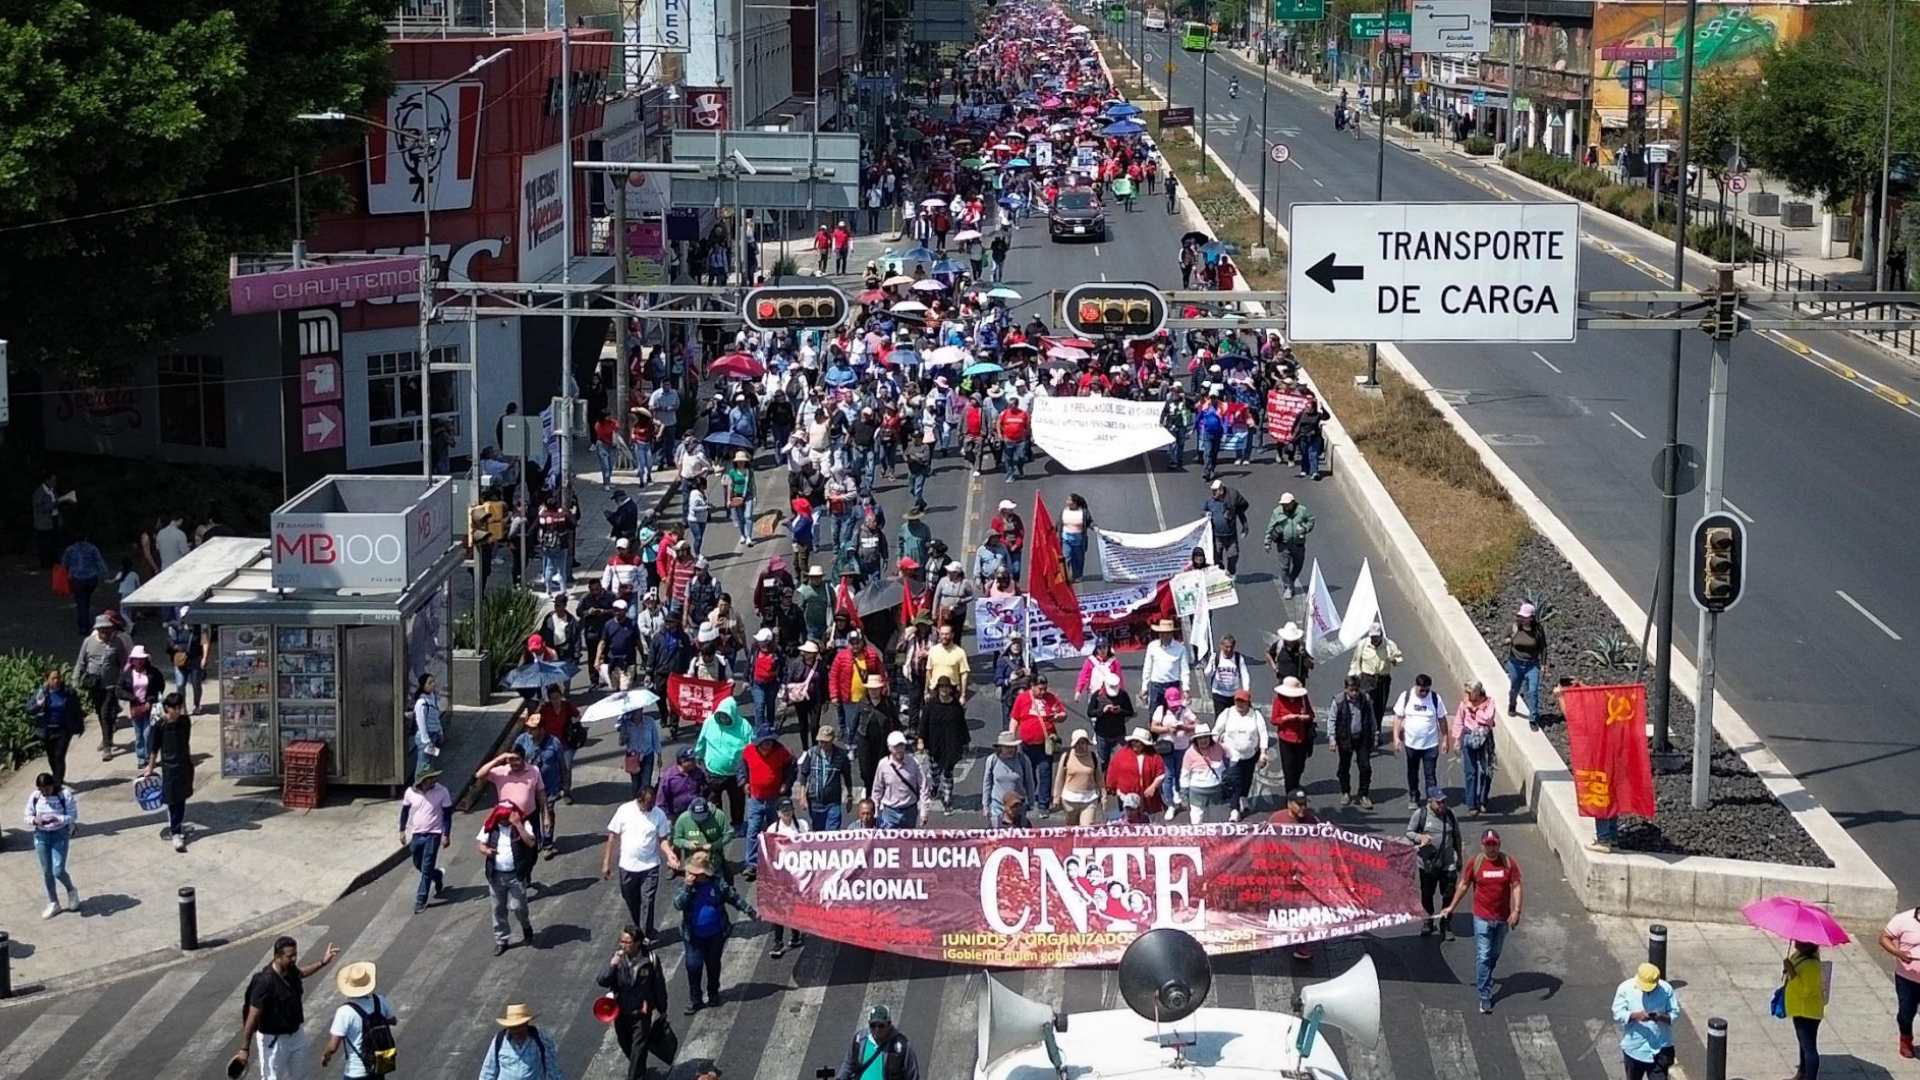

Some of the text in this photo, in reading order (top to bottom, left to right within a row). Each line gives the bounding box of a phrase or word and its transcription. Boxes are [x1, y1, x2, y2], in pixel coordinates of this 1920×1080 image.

[1378, 230, 1564, 260] TRANSPORTE
[1378, 285, 1559, 314] DE CARGA
[276, 533, 402, 565] MB100
[791, 822, 1383, 851] COORDINADORA NACIONAL DE TRABAJADORES DE LA EDUCACIÓN
[772, 847, 981, 871] JORNADA DE LUCHA
[822, 879, 928, 900] NACIONAL
[980, 846, 1205, 934] CNTE
[1025, 932, 1136, 946] ORGANIZADOS
